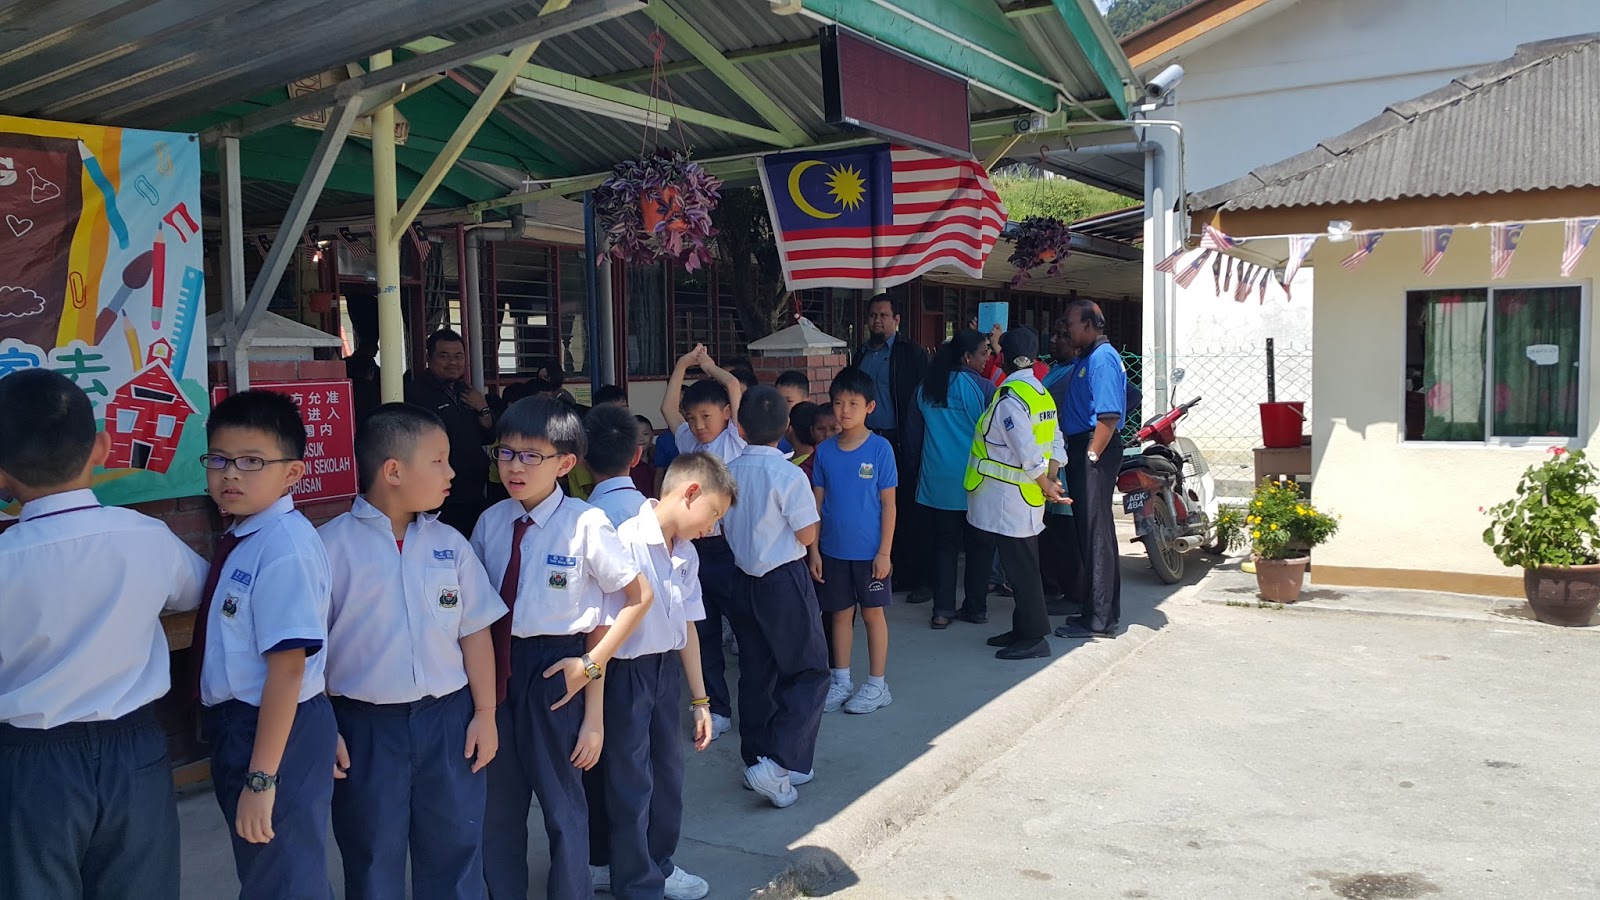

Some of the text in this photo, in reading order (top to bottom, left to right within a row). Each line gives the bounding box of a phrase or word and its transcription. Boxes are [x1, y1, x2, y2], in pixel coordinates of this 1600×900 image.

[306, 407, 340, 421] 进入
[304, 442, 324, 457] ASUK
[314, 457, 350, 474] SEKOLAH
[1129, 492, 1146, 502] AGK
[1127, 500, 1144, 510] 484
